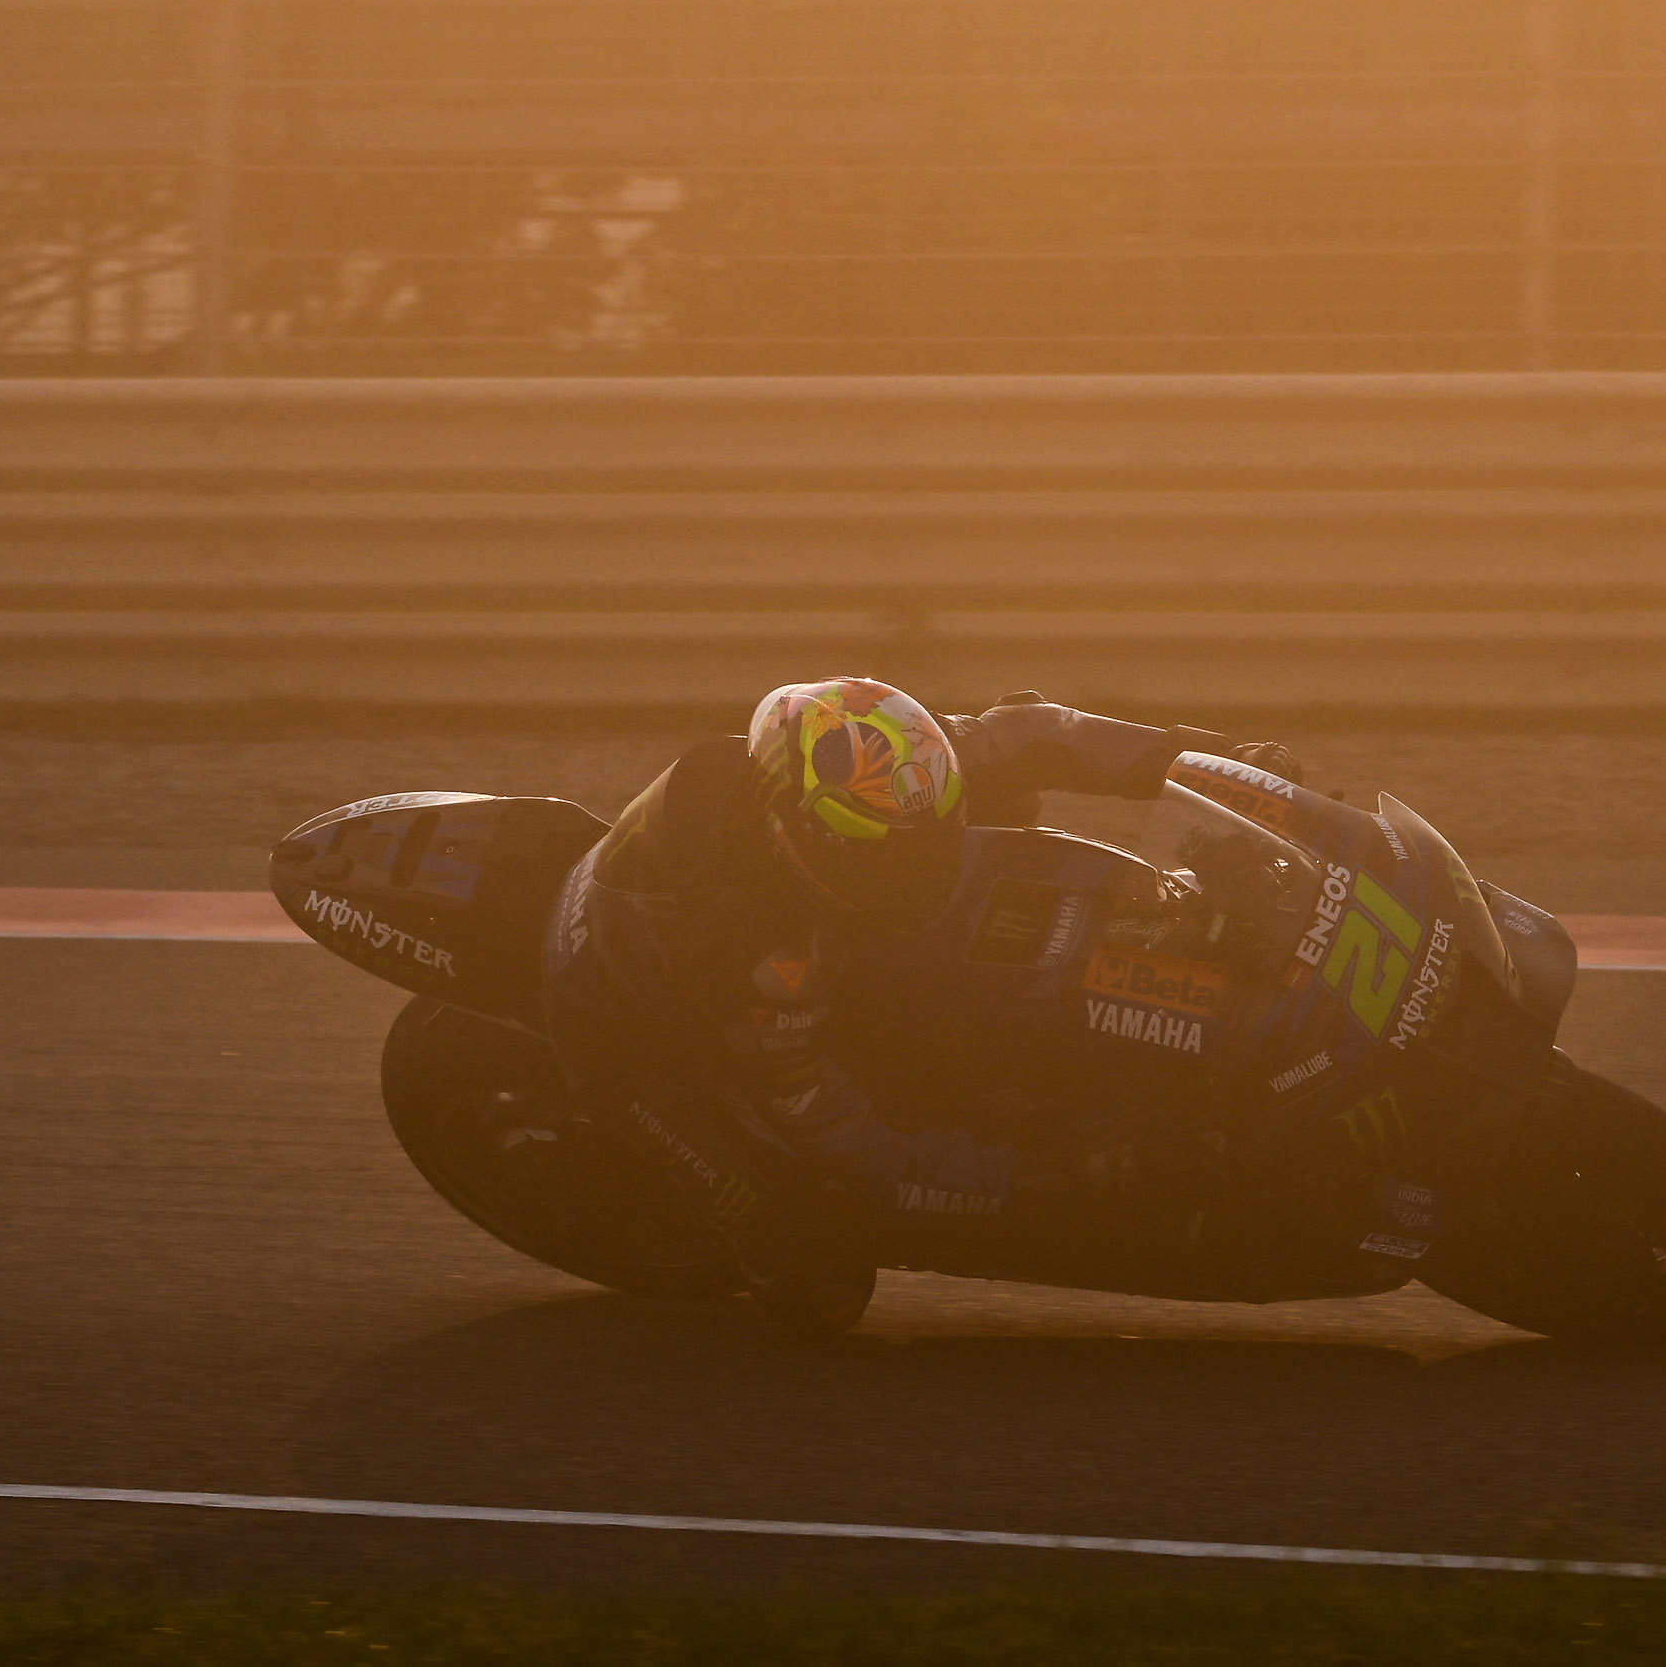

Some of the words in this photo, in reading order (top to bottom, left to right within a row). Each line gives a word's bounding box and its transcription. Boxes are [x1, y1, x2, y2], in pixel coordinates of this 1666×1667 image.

[1183, 754, 1295, 799] YAMAHA
[305, 890, 457, 977] MONSTER
[1045, 894, 1079, 957] YAMAHA
[1295, 862, 1351, 967] ENEOS
[1129, 963, 1217, 1007] Beta
[1318, 866, 1427, 1044] 21
[1389, 918, 1456, 1050] MONSTER
[1419, 943, 1461, 1039] ENERGY
[1087, 999, 1203, 1054] YAMAHA
[1269, 1049, 1334, 1095] YAMALUBE
[629, 1101, 718, 1189] MONSTER
[896, 1182, 1003, 1217] YAMAHA
